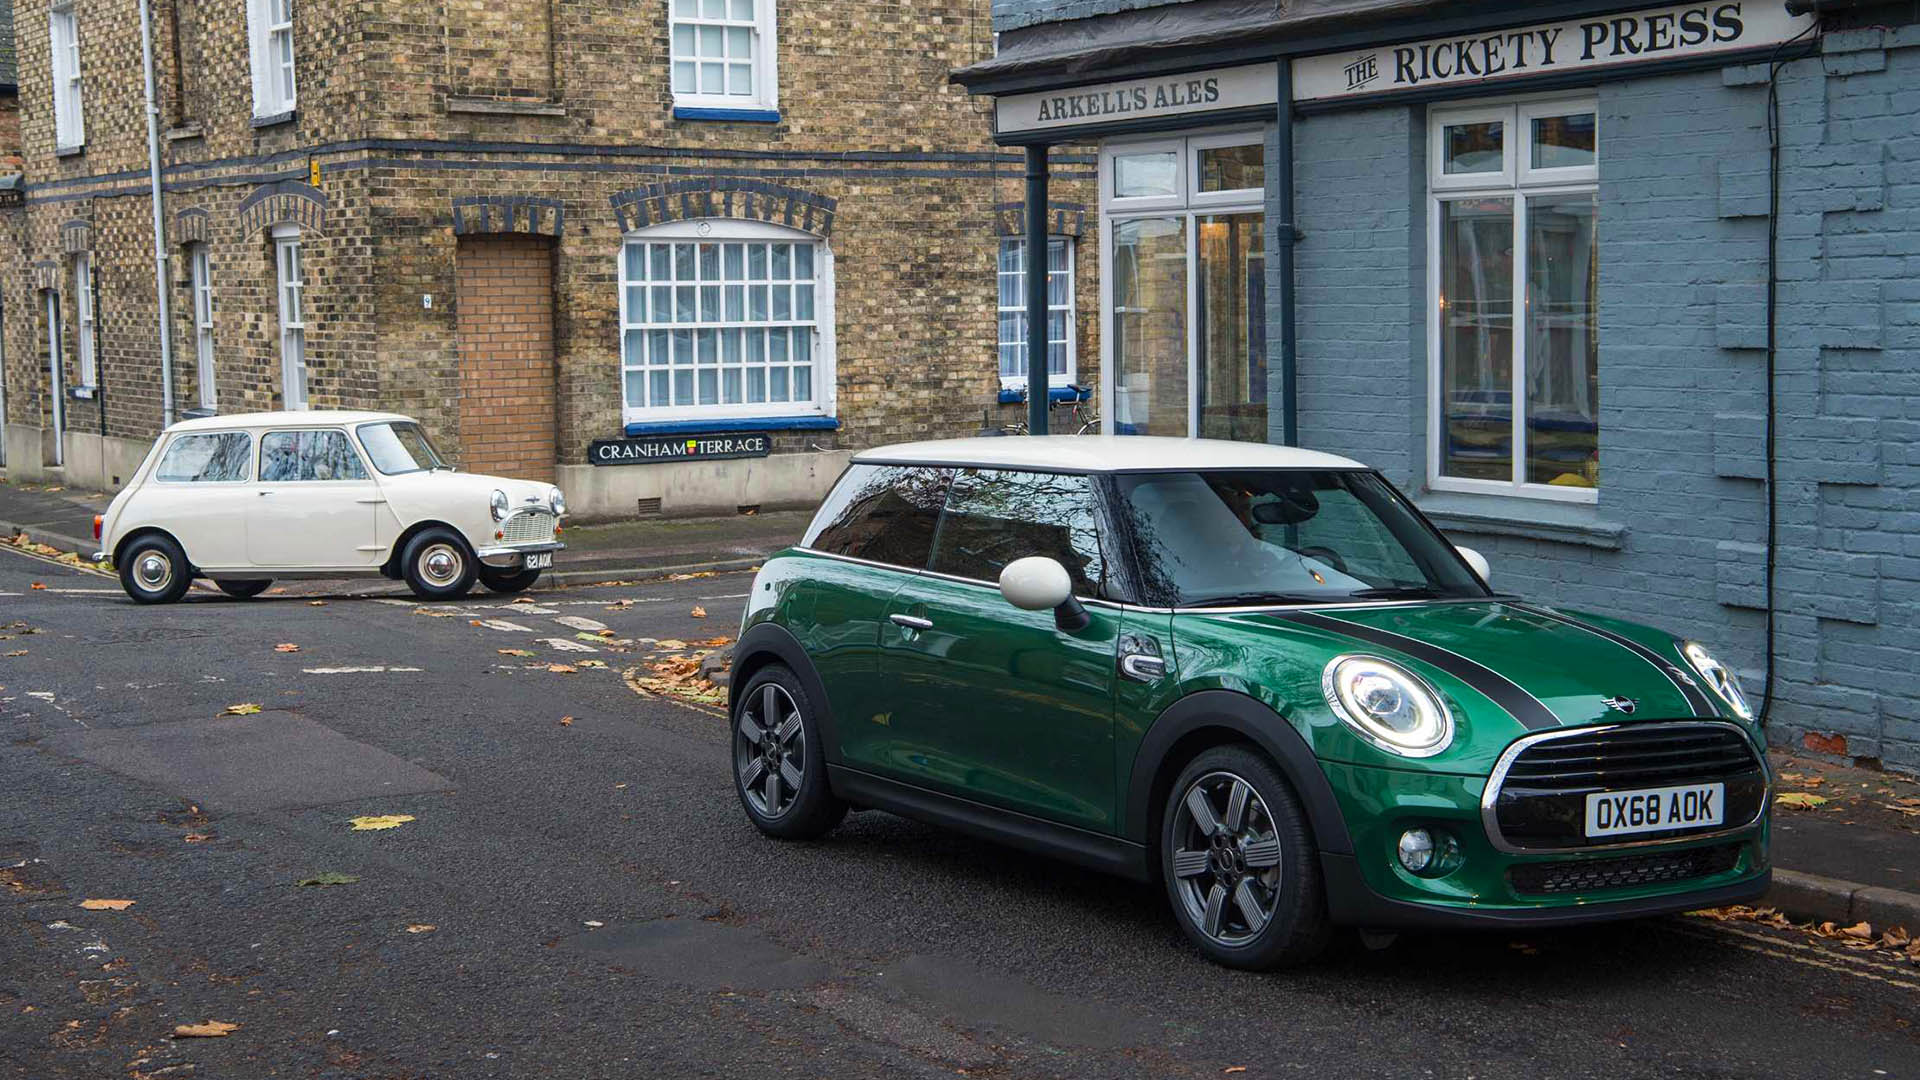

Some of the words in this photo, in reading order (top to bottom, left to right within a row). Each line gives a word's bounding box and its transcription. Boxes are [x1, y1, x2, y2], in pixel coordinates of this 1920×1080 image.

[1345, 60, 1379, 88] THE
[1393, 28, 1562, 84] RICKETY
[1580, 2, 1744, 61] PRESS
[1038, 86, 1147, 121] ARKELL'S
[1154, 78, 1220, 108] ALES
[599, 444, 687, 459] CRANHAM
[697, 439, 764, 454] TERRACE
[1597, 794, 1660, 829] OX68
[1668, 789, 1713, 823] AOK
